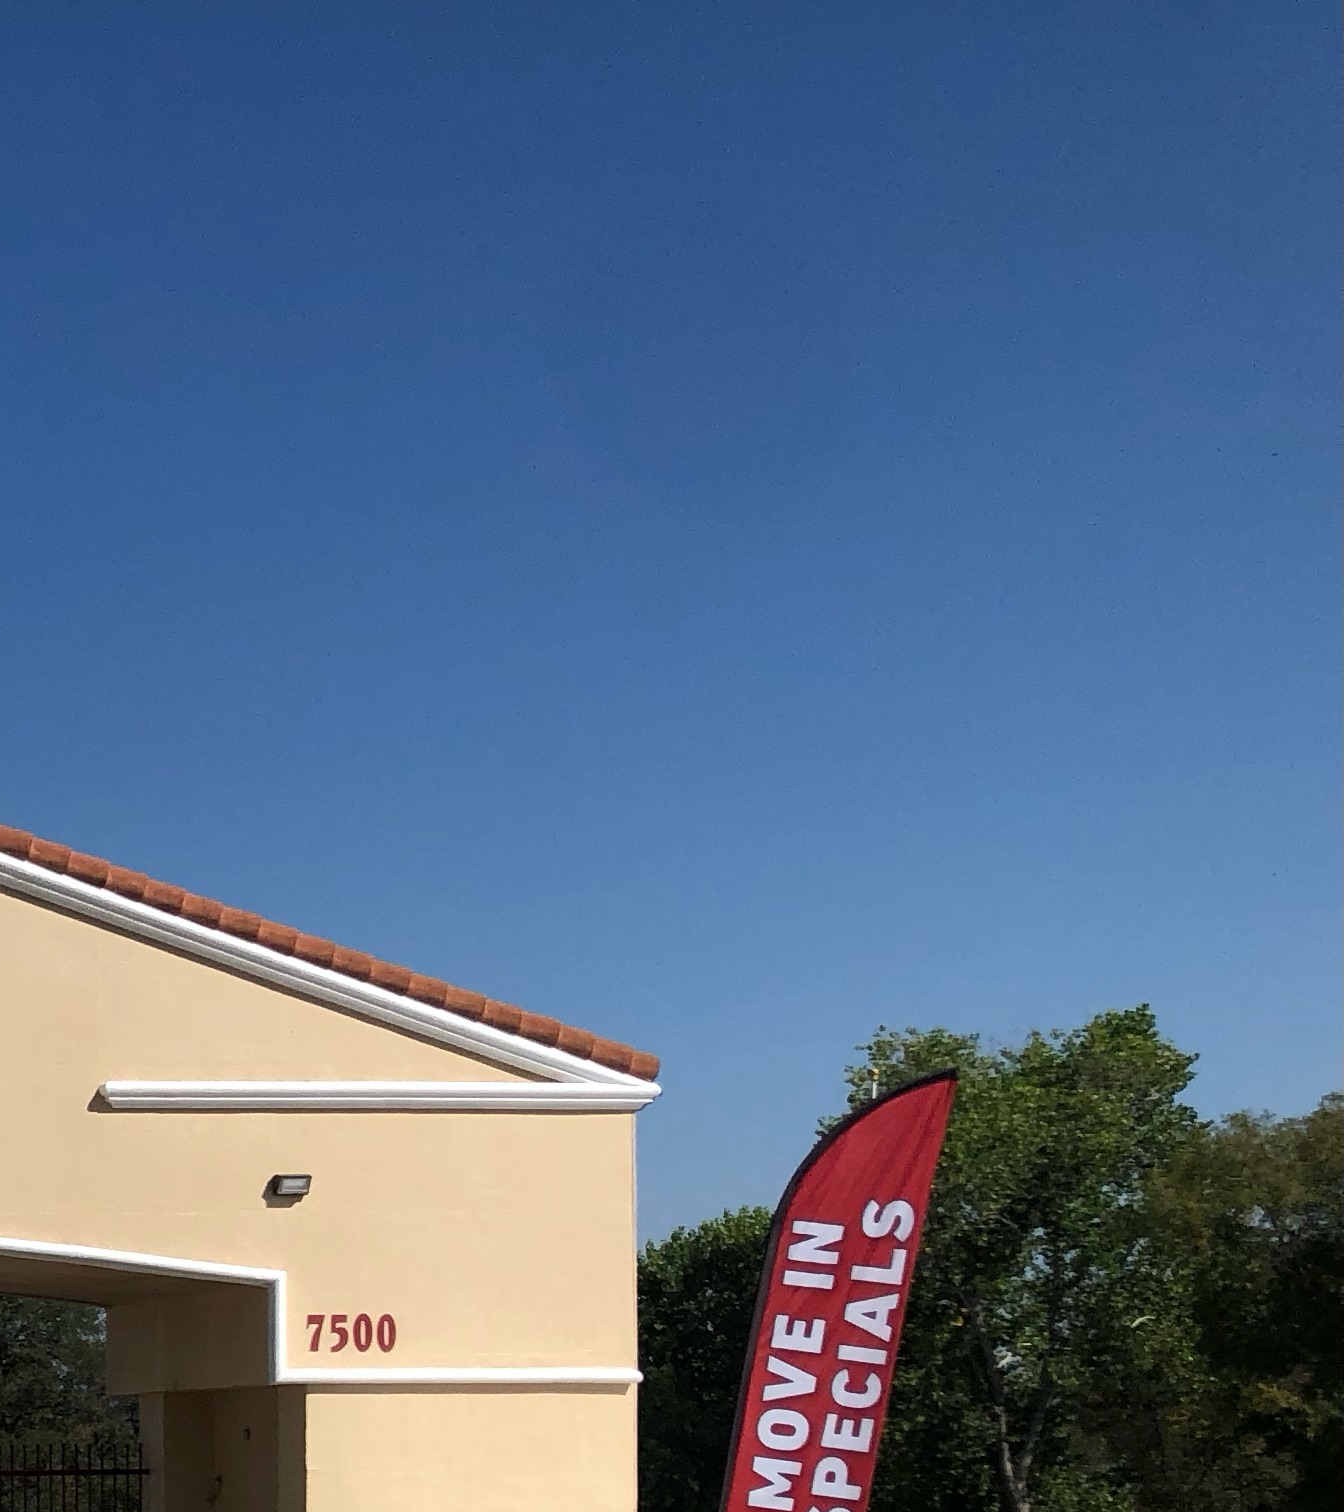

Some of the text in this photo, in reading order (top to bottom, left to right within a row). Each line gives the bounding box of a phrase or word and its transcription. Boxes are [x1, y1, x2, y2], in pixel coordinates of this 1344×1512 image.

[305, 1313, 397, 1353] 7500
[746, 1219, 845, 1512] MOVE IN
